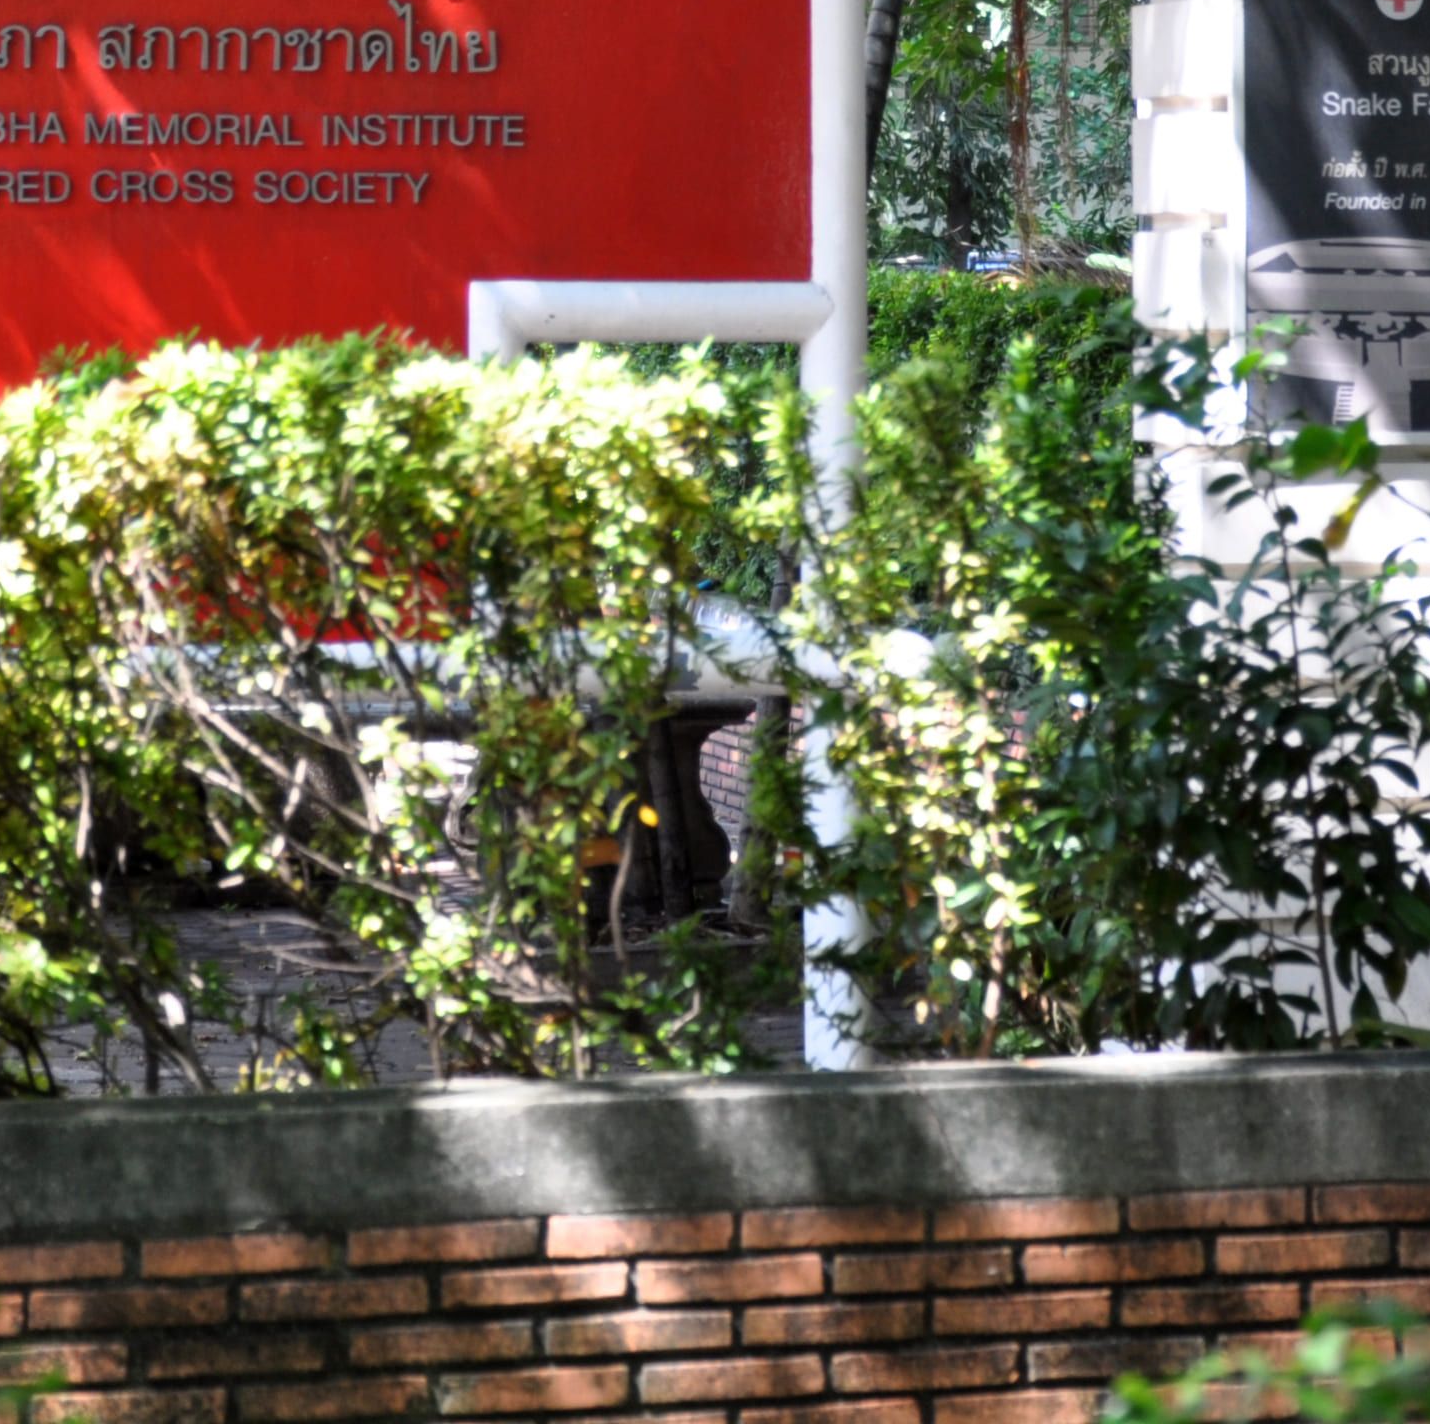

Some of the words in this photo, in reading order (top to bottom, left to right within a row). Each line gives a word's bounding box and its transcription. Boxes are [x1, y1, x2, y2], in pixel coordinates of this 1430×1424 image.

[97, 0, 498, 73] สภากาชาดไทย
[1322, 91, 1402, 117] Snake
[83, 112, 304, 147] MEMORIAL
[322, 114, 525, 148] INSTITUTE
[1322, 149, 1368, 178] ก่อตั้ง
[91, 170, 234, 205] CROSS
[253, 171, 430, 205] SOCIETY
[1324, 192, 1406, 211] Founded
[1410, 192, 1427, 211] in
